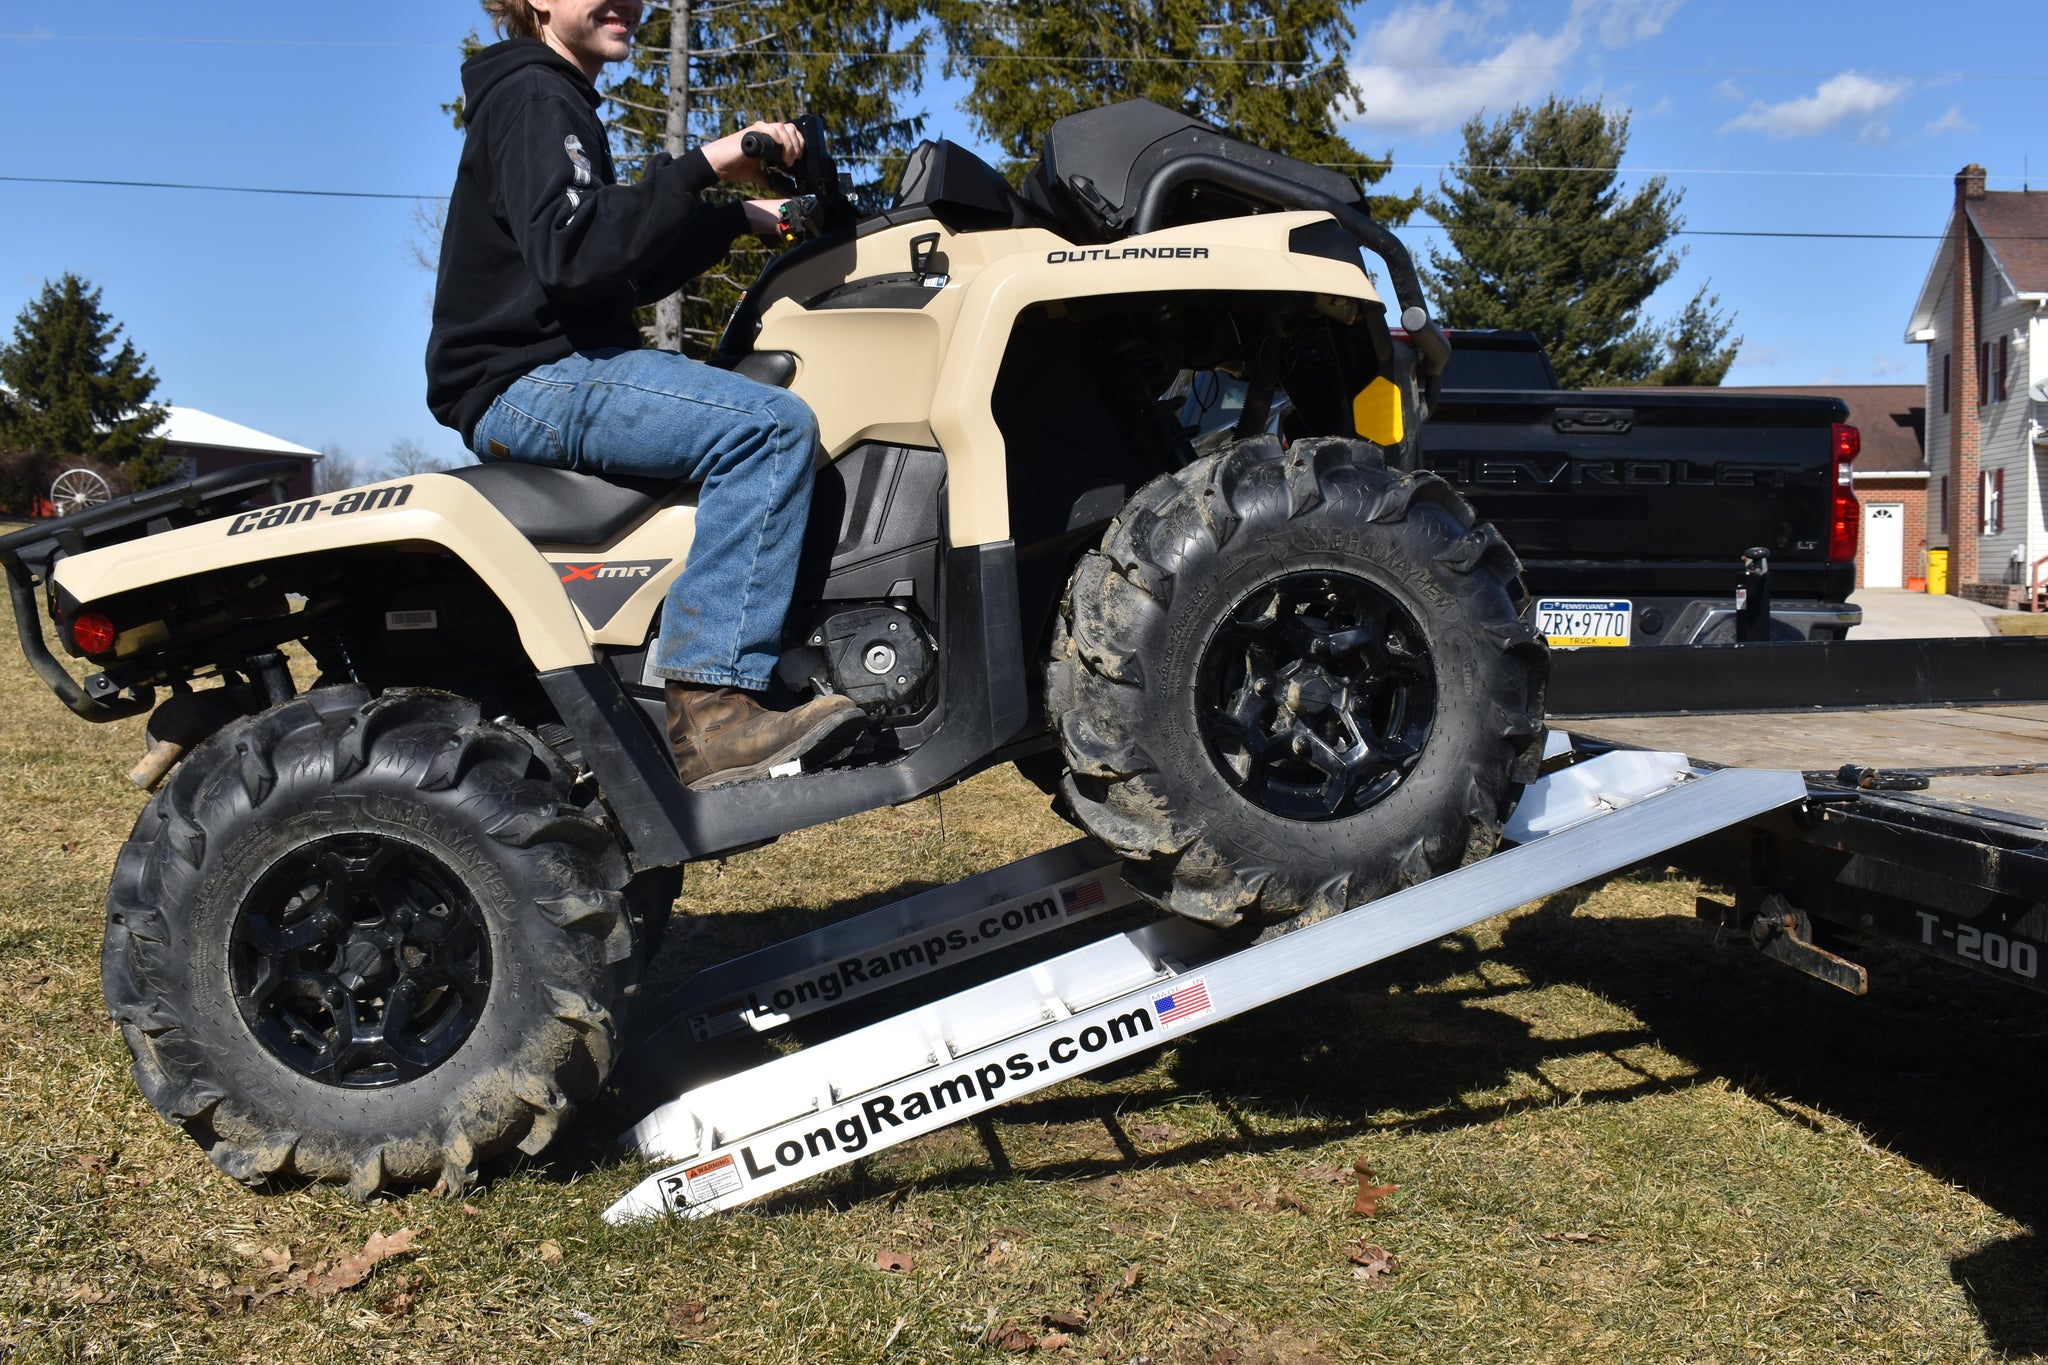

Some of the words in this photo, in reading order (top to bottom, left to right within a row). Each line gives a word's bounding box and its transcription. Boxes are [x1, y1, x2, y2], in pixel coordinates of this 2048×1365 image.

[1047, 247, 1209, 264] OUTLANDER
[1422, 459, 1799, 487] HEVROLET
[226, 484, 414, 536] can-am
[745, 897, 1058, 1017] LongRamps.com
[1916, 910, 2037, 978] T-200
[1151, 986, 1181, 1001] MADE
[1192, 978, 1204, 986] IN
[740, 1007, 1154, 1179] LongRamps.com
[697, 1157, 730, 1174] WARNING
